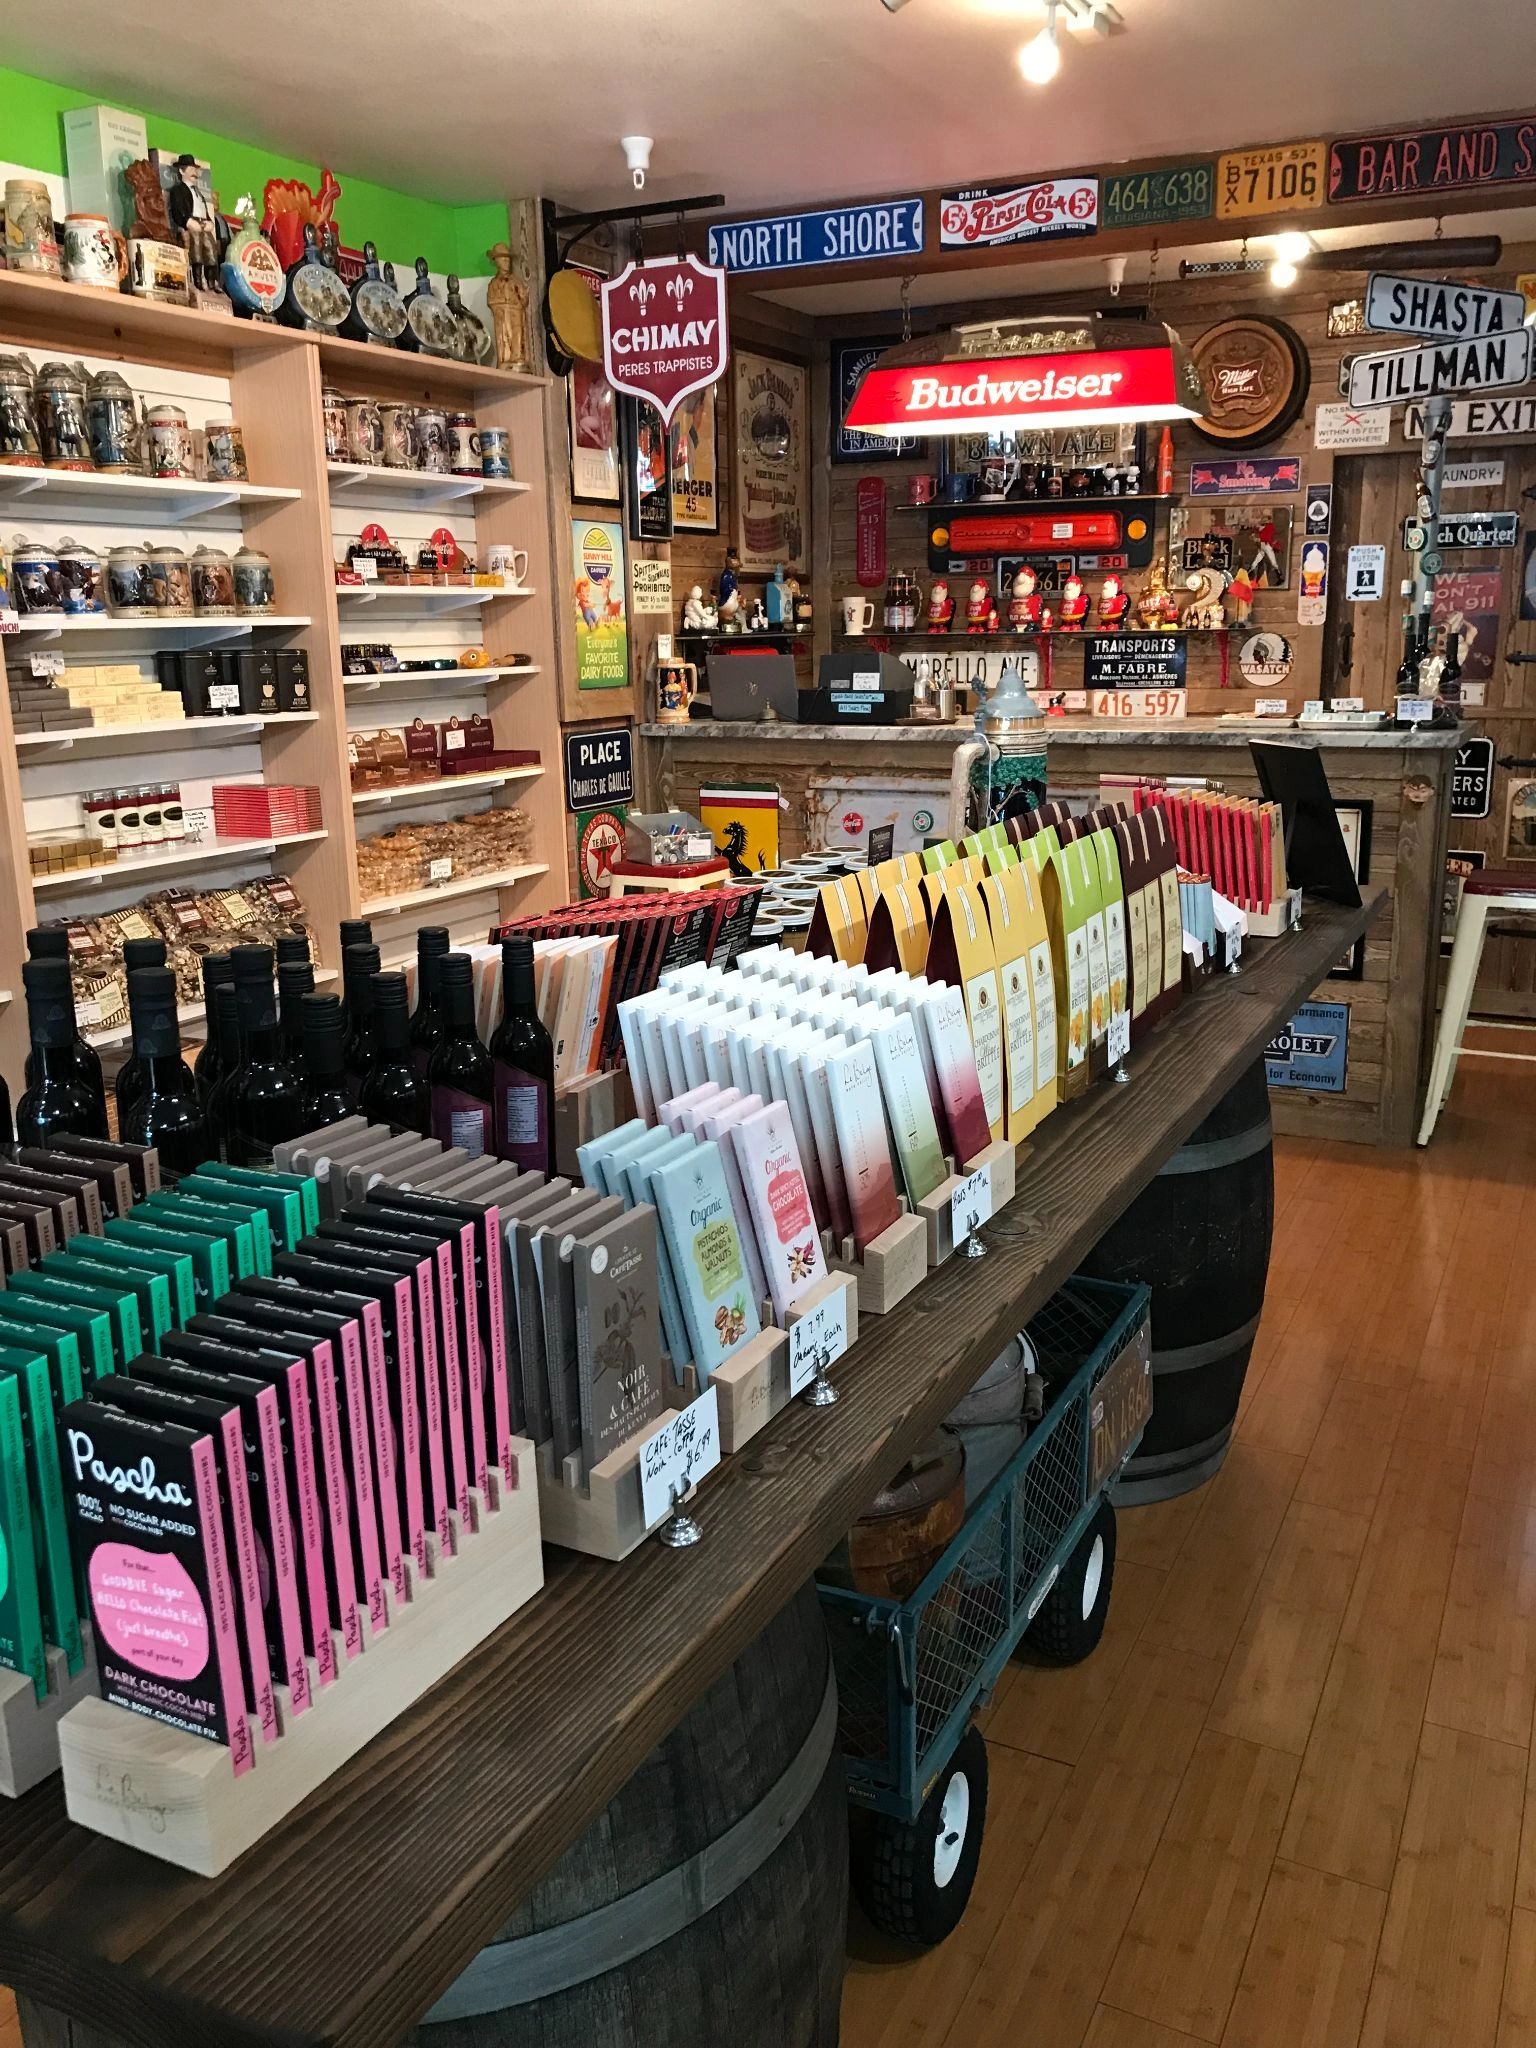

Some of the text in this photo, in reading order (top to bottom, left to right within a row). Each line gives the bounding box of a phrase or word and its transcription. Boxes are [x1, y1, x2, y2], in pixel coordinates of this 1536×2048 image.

[1243, 151, 1283, 167] TEXAS
[1359, 142, 1420, 194] BAR
[1433, 131, 1498, 185] AND
[958, 188, 989, 200] DRINK
[1108, 170, 1209, 213] 464 638
[1243, 162, 1318, 204] 7106
[722, 206, 909, 268] NORTH SHORE
[1389, 283, 1504, 335] SHASTA
[610, 318, 717, 354] CHIMAY
[618, 356, 713, 377] PERES TRAPPISTES
[1218, 368, 1258, 388] Miller
[1368, 339, 1507, 400] TILLMAN
[905, 370, 1123, 412] Budweiser
[1467, 400, 1536, 433] EXIT
[843, 430, 863, 440] THE
[849, 439, 861, 450] IN
[1061, 431, 1117, 457] ALE
[1332, 434, 1384, 444] ANYWHERE
[1218, 474, 1271, 489] Smoking
[685, 497, 697, 513] 45
[1457, 524, 1516, 545] Quarter
[583, 552, 613, 561] SUNNY HILL
[1101, 556, 1122, 568] 20
[633, 562, 659, 578] SPITTING
[647, 568, 670, 583] SIDEWALKS
[1434, 572, 1471, 585] WE
[633, 581, 671, 593] PROHIBITED
[1465, 596, 1495, 610] 911
[1094, 638, 1177, 653] TRANSPORTS
[585, 651, 619, 665] FAVORITE
[1101, 663, 1167, 674] M. FABRE
[1240, 663, 1291, 675] WASATCH
[581, 664, 624, 680] DAIRY FOODS
[906, 657, 987, 685] MRELLO
[1098, 694, 1133, 716] 416
[1144, 693, 1180, 716] 597
[580, 740, 622, 767] PLACE
[572, 770, 631, 799] CHARLES DE GAULLE
[592, 835, 617, 848] TEXACO
[1010, 1030, 1033, 1054] BRITTLE
[1269, 1068, 1337, 1086] for Economy
[765, 1151, 792, 1178] Organic
[772, 1183, 804, 1213] CHOCOLATE
[690, 1197, 723, 1230] Organic
[697, 1222, 729, 1249] PISTACHIOS
[700, 1237, 727, 1262] ALMONDS
[704, 1246, 732, 1273] WALNUTS
[617, 1363, 647, 1392] NOIR
[609, 1404, 618, 1421] &
[67, 1428, 193, 1507] Pascha
[200, 1455, 209, 1478] NIBS
[203, 1478, 215, 1512] COCOA
[76, 1492, 197, 1537] 100% NO SUGAR ADDED
[79, 1508, 105, 1522] CACAO
[207, 1512, 220, 1555] ORGANIC
[212, 1555, 223, 1577] WITH
[102, 1572, 185, 1603] GOODBYE Sugar
[215, 1576, 226, 1613] CACAO
[95, 1590, 127, 1611] HELLO
[104, 1664, 137, 1687] DARK
[139, 1679, 217, 1716] CHOCOLATE
[153, 1707, 203, 1735] CHOCOLATE
